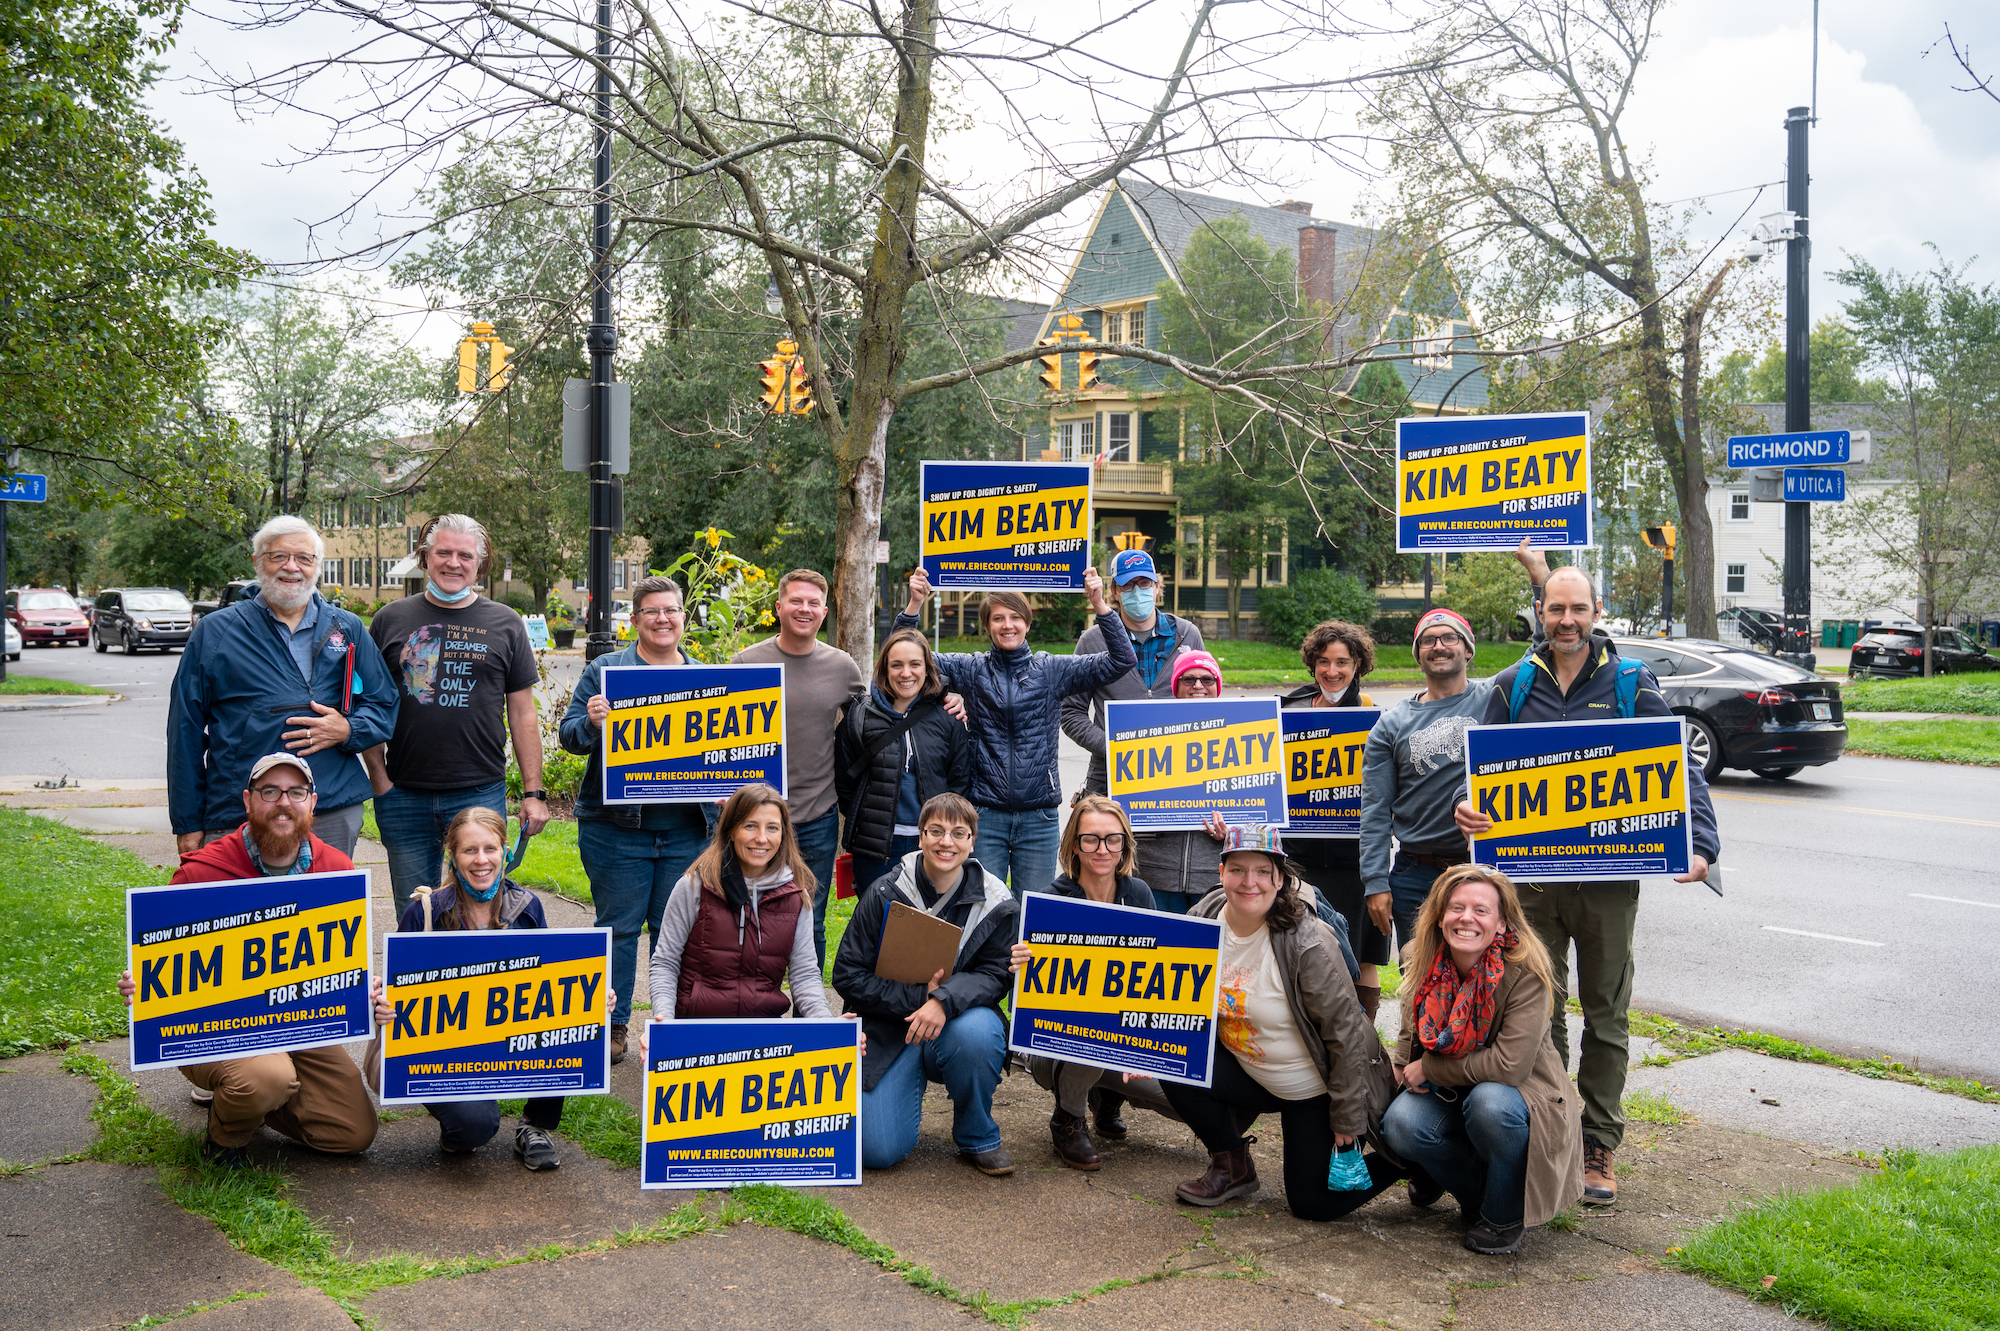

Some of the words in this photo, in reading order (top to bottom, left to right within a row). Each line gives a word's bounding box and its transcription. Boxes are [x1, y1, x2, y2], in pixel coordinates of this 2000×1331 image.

[1407, 450, 1430, 460] SHOW
[1431, 448, 1442, 457] UP
[1443, 445, 1458, 455] FOR
[1459, 441, 1490, 453] DIGNITY
[1491, 440, 1498, 449] &
[1500, 436, 1526, 448] SAFETY
[1732, 440, 1830, 460] RICHMOND
[33, 480, 40, 495] ST
[1405, 464, 1467, 503] KIM
[1481, 449, 1582, 493] BEATY
[1786, 477, 1796, 492] W
[1800, 477, 1833, 494] UTICA
[1837, 477, 1842, 494] ST
[930, 492, 950, 502] SHOW
[952, 491, 962, 500] UP
[963, 490, 976, 499] FOR
[977, 487, 1005, 497] DIGNITY
[1006, 486, 1012, 494] &
[1013, 483, 1037, 494] SAFETY
[1502, 498, 1526, 514] FOR
[1530, 491, 1581, 511] SHERIFF
[928, 508, 984, 543] KIM
[996, 498, 1085, 536] BEATY
[1419, 519, 1567, 530] WWW.ERIECOUNTYSURJ.COM
[1014, 543, 1035, 557] FOR
[1038, 538, 1083, 555] SHERIFF
[940, 562, 1069, 572] WWW.ERIECOUNTYSURJ.COM
[445, 640, 488, 653] DREAMER
[446, 631, 460, 640] I'M
[472, 652, 486, 660] NOT
[443, 661, 473, 675] THE
[440, 678, 477, 692] ONLY
[438, 693, 469, 707] ONE
[613, 698, 635, 709] SHOW
[637, 697, 647, 706] UP
[648, 695, 662, 705] FOR
[664, 691, 693, 703] DIGNITY
[694, 690, 700, 699] &
[702, 686, 727, 698] SAFETY
[612, 714, 671, 753] KIM
[685, 701, 778, 743] BEATY
[1116, 730, 1136, 741] SHOW
[1138, 729, 1148, 738] UP
[1149, 727, 1162, 736] FOR
[1164, 723, 1191, 734] DIGNITY
[1193, 722, 1199, 730] &
[1201, 718, 1225, 729] SAFETY
[1283, 733, 1299, 743] NITY
[1300, 732, 1306, 740] &
[1307, 728, 1330, 739] SAFETY
[704, 749, 727, 765] FOR
[730, 742, 777, 762] SHERIFF
[1115, 745, 1172, 782] KIM
[1186, 732, 1275, 773] BEATY
[1291, 743, 1367, 782] BEAT
[1478, 762, 1503, 775] SHOW
[1505, 760, 1517, 771] UP
[1519, 757, 1535, 769] FOR
[1537, 752, 1572, 766] DIGNITY
[1573, 750, 1581, 761] &
[1583, 745, 1613, 759] SAFETY
[625, 770, 764, 781] WWW.ERIECOUNTYSURJ.COM
[1206, 778, 1227, 794] FOR
[1230, 772, 1276, 790] SHERIFF
[1129, 799, 1265, 809] WWW.ERIECOUNTYSURJ.COM
[1309, 789, 1330, 803] FOR
[1333, 785, 1362, 800] SHER
[1478, 779, 1548, 825] KIM
[1565, 761, 1678, 813] BEATY
[1590, 819, 1617, 838] FOR
[1621, 810, 1679, 834] SHERIFF
[1496, 843, 1664, 857] WWW.ERIECOUNTYSURJ.COM
[142, 928, 173, 944] SHOW
[175, 924, 189, 938] UP
[192, 920, 210, 934] FOR
[212, 912, 251, 930] DIGNITY
[253, 910, 262, 922] &
[264, 903, 297, 920] SAFETY
[1031, 933, 1054, 944] SHOW
[1056, 934, 1067, 944] UP
[1068, 935, 1084, 945] FOR
[1085, 935, 1118, 947] DIGNITY
[1118, 936, 1126, 947] &
[1127, 936, 1156, 948] SAFETY
[141, 945, 223, 1003] KIM
[242, 916, 362, 981] BEATY
[397, 972, 424, 986] SHOW
[426, 970, 439, 981] UP
[441, 967, 458, 979] FOR
[460, 962, 497, 977] DIGNITY
[498, 960, 506, 971] &
[509, 955, 540, 970] SAFETY
[268, 983, 298, 1006] FOR
[302, 969, 361, 998] SHERIFF
[1023, 956, 1091, 996] KIM
[1102, 960, 1213, 1002] BEATY
[392, 991, 469, 1040] KIM
[485, 972, 602, 1027] BEATY
[160, 1005, 346, 1038] WWW.ERIECOUNTYSURJ.COM
[1121, 1011, 1148, 1028] FOR
[1150, 1013, 1206, 1032] SHERIFF
[509, 1032, 537, 1053] FOR
[541, 1023, 599, 1048] SHERIFF
[1034, 1018, 1188, 1056] WWW.ERIECOUNTYSURJ.COM
[408, 1058, 582, 1075] WWW.ERIECOUNTYSURJ.COM
[657, 1059, 683, 1072] SHOW
[685, 1057, 697, 1068] UP
[699, 1054, 715, 1066] FOR
[717, 1050, 752, 1064] DIGNITY
[754, 1049, 761, 1060] &
[763, 1044, 793, 1058] SAFETY
[653, 1078, 726, 1126] KIM
[741, 1062, 852, 1114] BEATY
[763, 1121, 791, 1141] FOR
[794, 1113, 850, 1137] SHERIFF
[668, 1148, 834, 1160] WWW.ERIECOUNTYSURJ.COM
